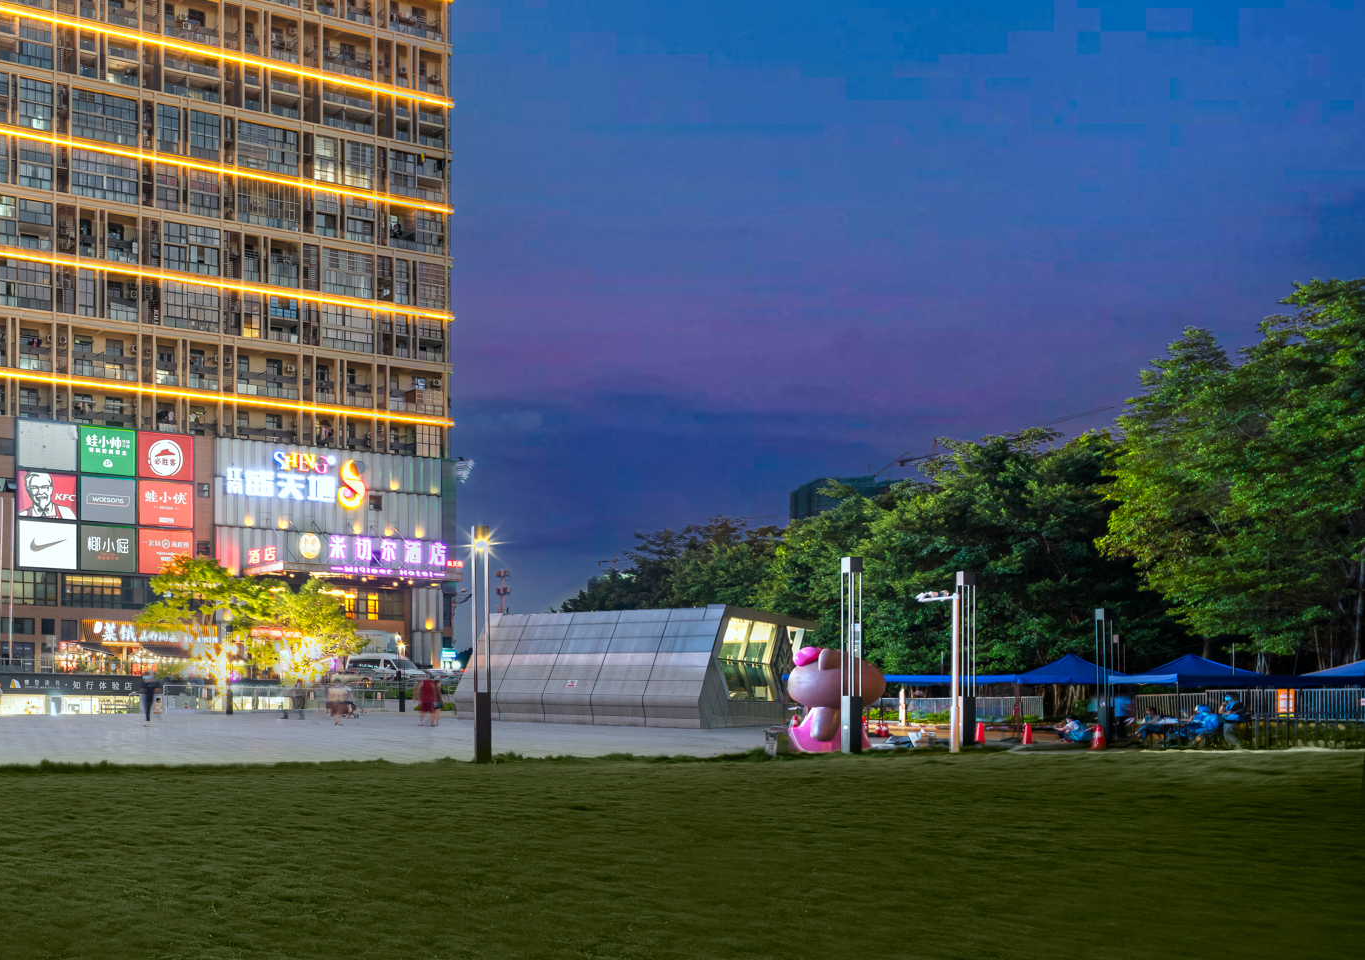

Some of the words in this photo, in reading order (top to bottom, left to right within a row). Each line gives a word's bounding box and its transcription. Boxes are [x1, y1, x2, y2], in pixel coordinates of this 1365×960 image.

[85, 434, 122, 450] 蛙小帅
[154, 457, 177, 467] 必胜客
[54, 492, 76, 502] KFC
[92, 495, 125, 505] watsons
[144, 490, 188, 505] 蛙小侠
[87, 536, 129, 554] 椰小倔
[328, 535, 448, 566] 米切尔酒店
[248, 546, 276, 565] 酒店
[72, 680, 133, 691] 知行体验店
